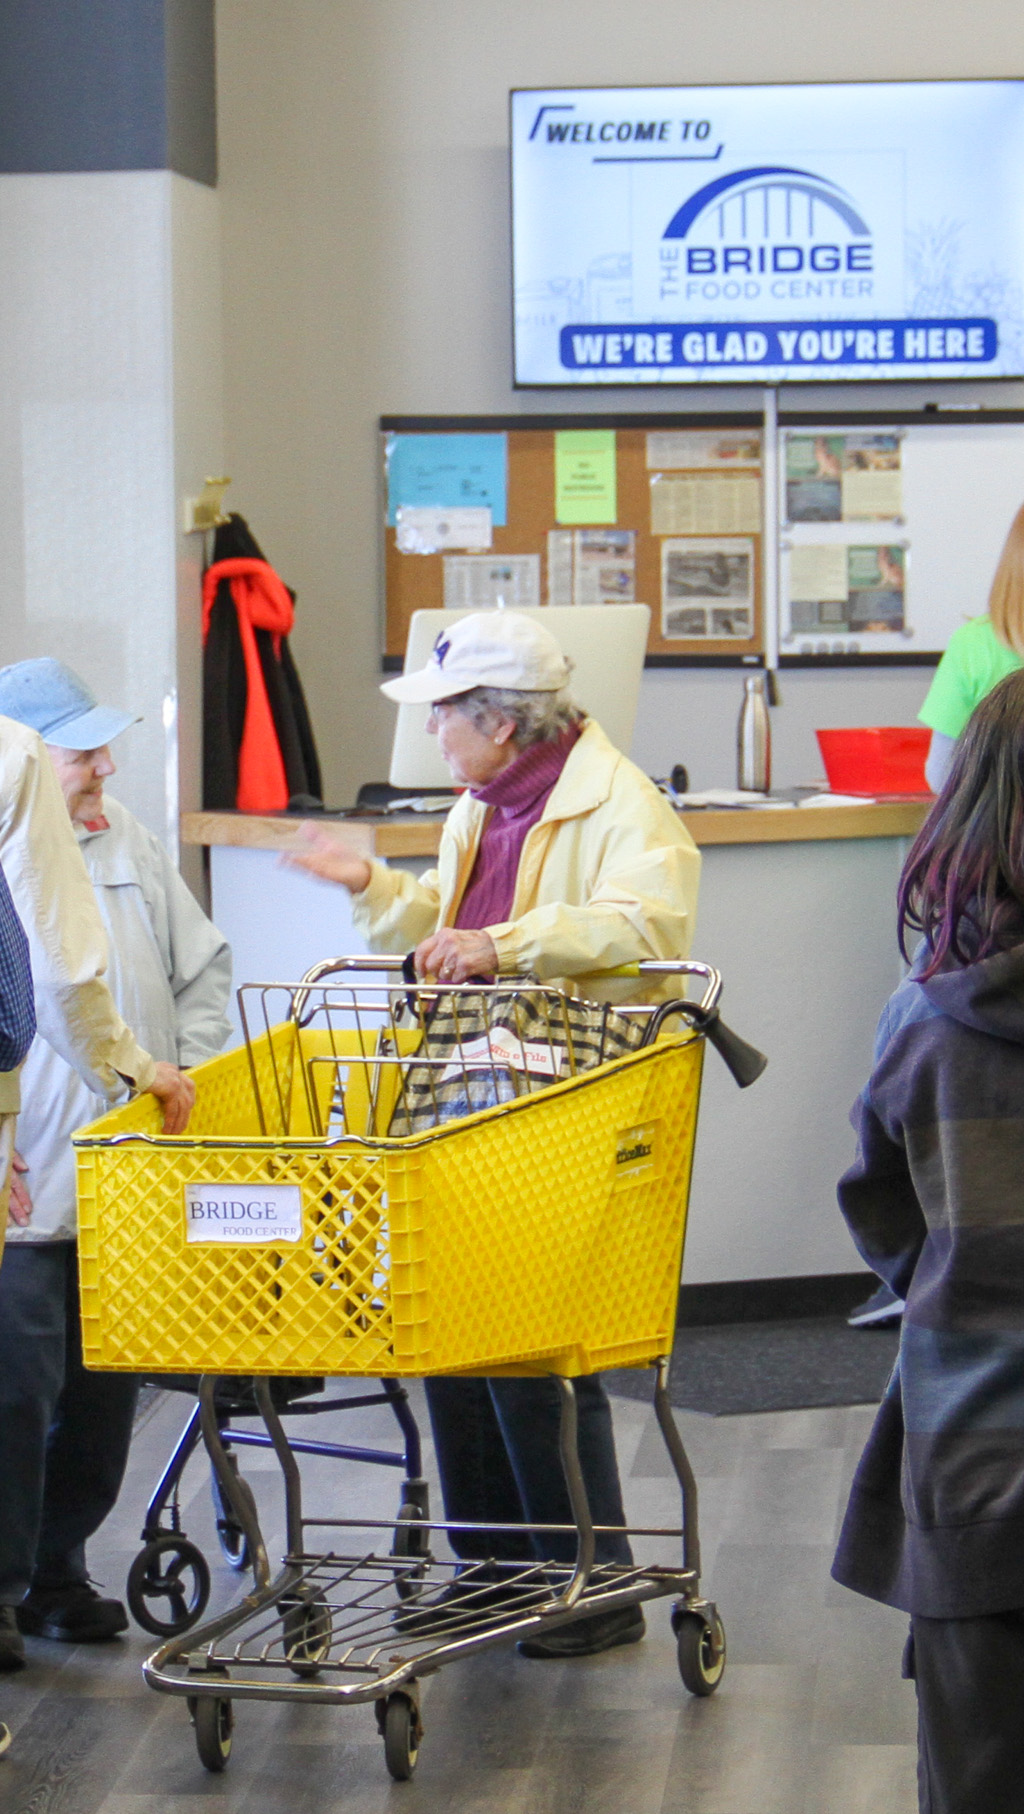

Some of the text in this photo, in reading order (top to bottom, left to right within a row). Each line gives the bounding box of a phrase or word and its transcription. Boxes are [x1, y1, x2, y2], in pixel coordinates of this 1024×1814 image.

[547, 119, 712, 142] WELCOME TO
[687, 244, 873, 274] BRIDGE
[660, 247, 679, 299] THE
[686, 279, 874, 300] FOOD CENTER
[572, 326, 985, 365] WE'RE GLAD YOU'RE HERE
[189, 1201, 278, 1220] BRIDGE
[223, 1226, 297, 1237] FOOD CENTER
